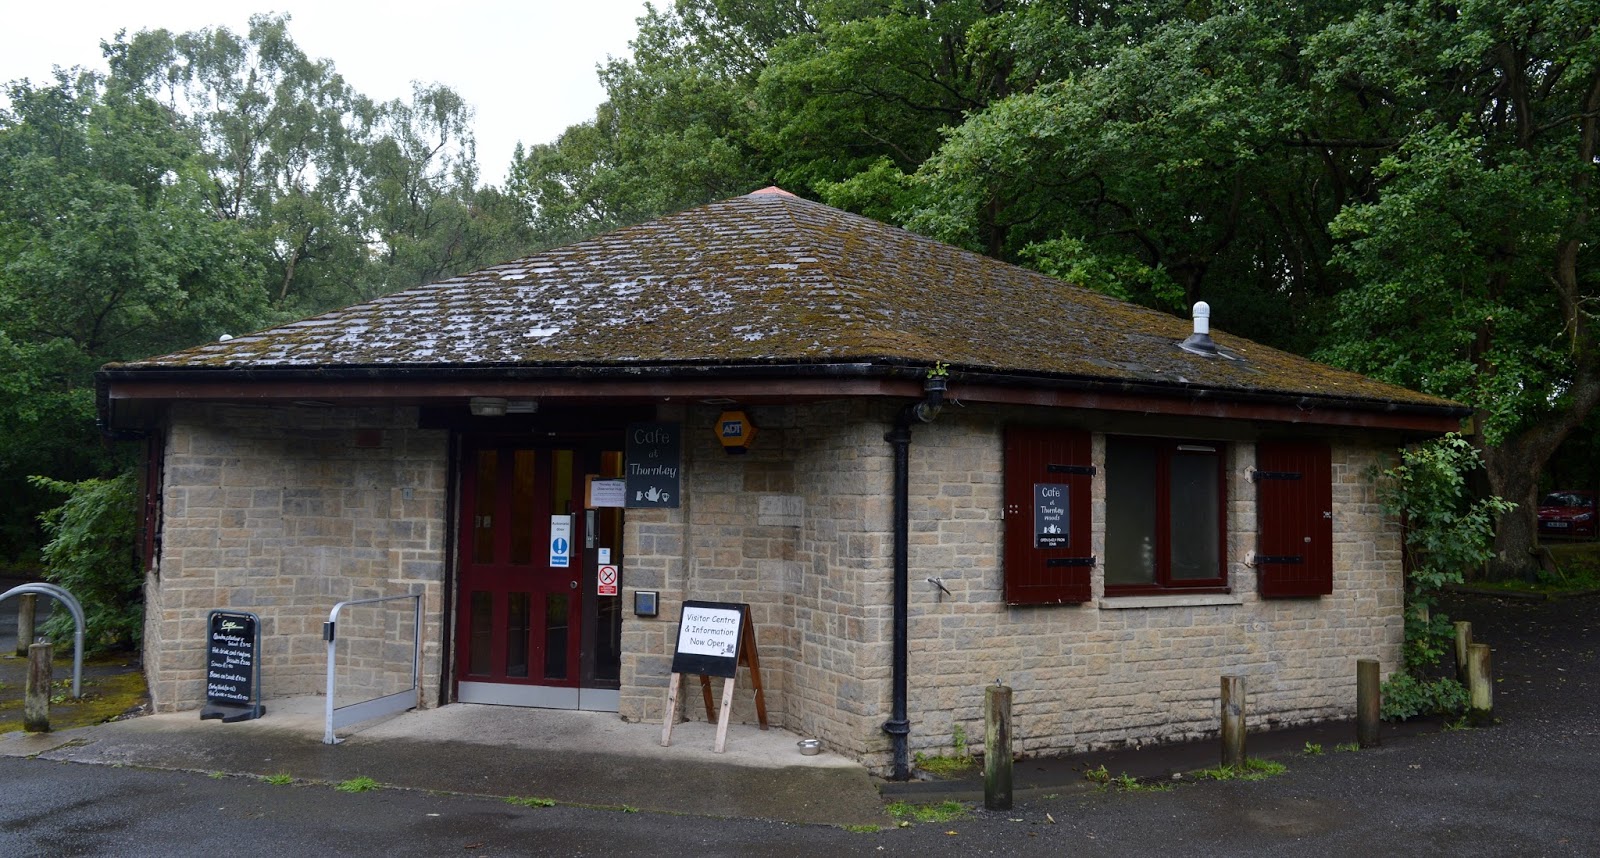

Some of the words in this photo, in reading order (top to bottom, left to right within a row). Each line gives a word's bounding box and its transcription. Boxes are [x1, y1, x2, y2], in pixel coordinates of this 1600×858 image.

[723, 424, 742, 434] ADT
[634, 428, 670, 444] Cafe
[649, 450, 659, 458] at
[630, 463, 677, 478] Thornley
[1042, 487, 1060, 497] Cafe
[1041, 506, 1064, 515] Thornley
[687, 614, 711, 622] Visitor
[711, 615, 736, 624] Centre
[685, 625, 690, 633] &
[692, 625, 734, 636] Information
[690, 637, 705, 646] Now
[707, 638, 725, 648] Open
